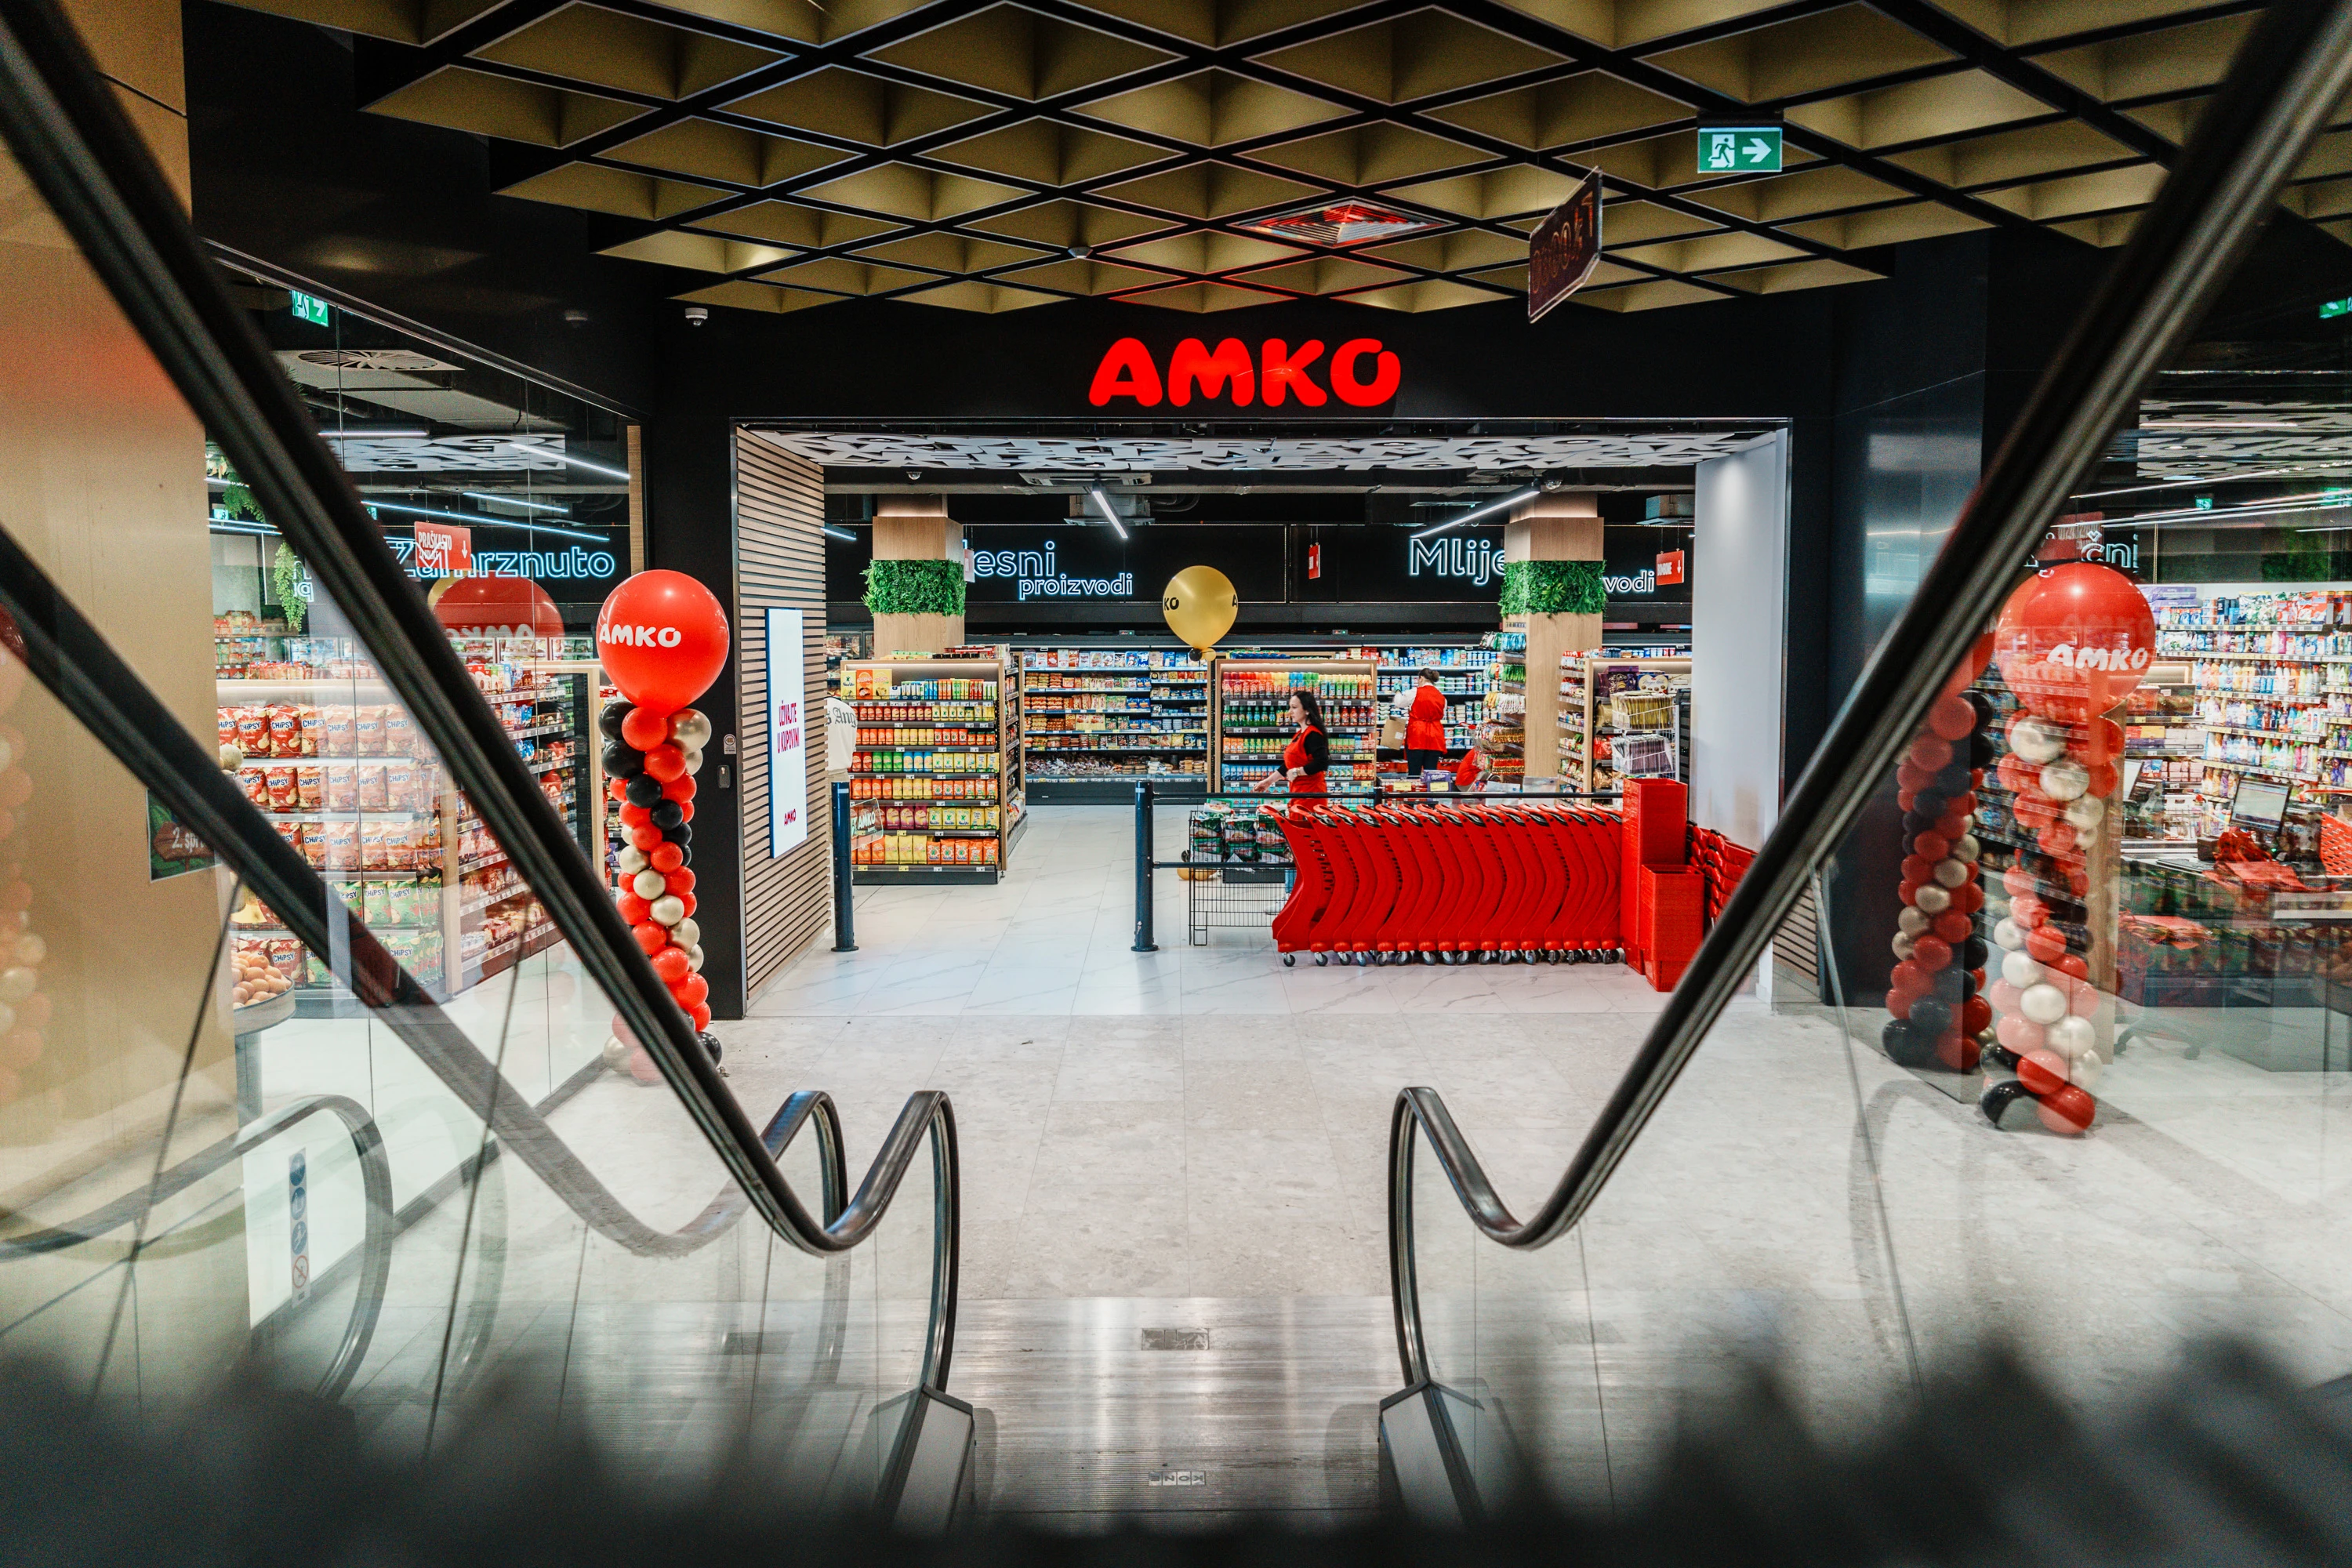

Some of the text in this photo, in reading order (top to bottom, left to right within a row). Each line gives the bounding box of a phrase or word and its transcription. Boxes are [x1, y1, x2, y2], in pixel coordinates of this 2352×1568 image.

[1088, 337, 1401, 407] AMKO
[962, 539, 1055, 577] esni
[1018, 573, 1133, 601] proizvodi
[599, 622, 682, 648] AMKO
[2046, 644, 2148, 671] AMKO
[858, 811, 876, 830] AMKO
